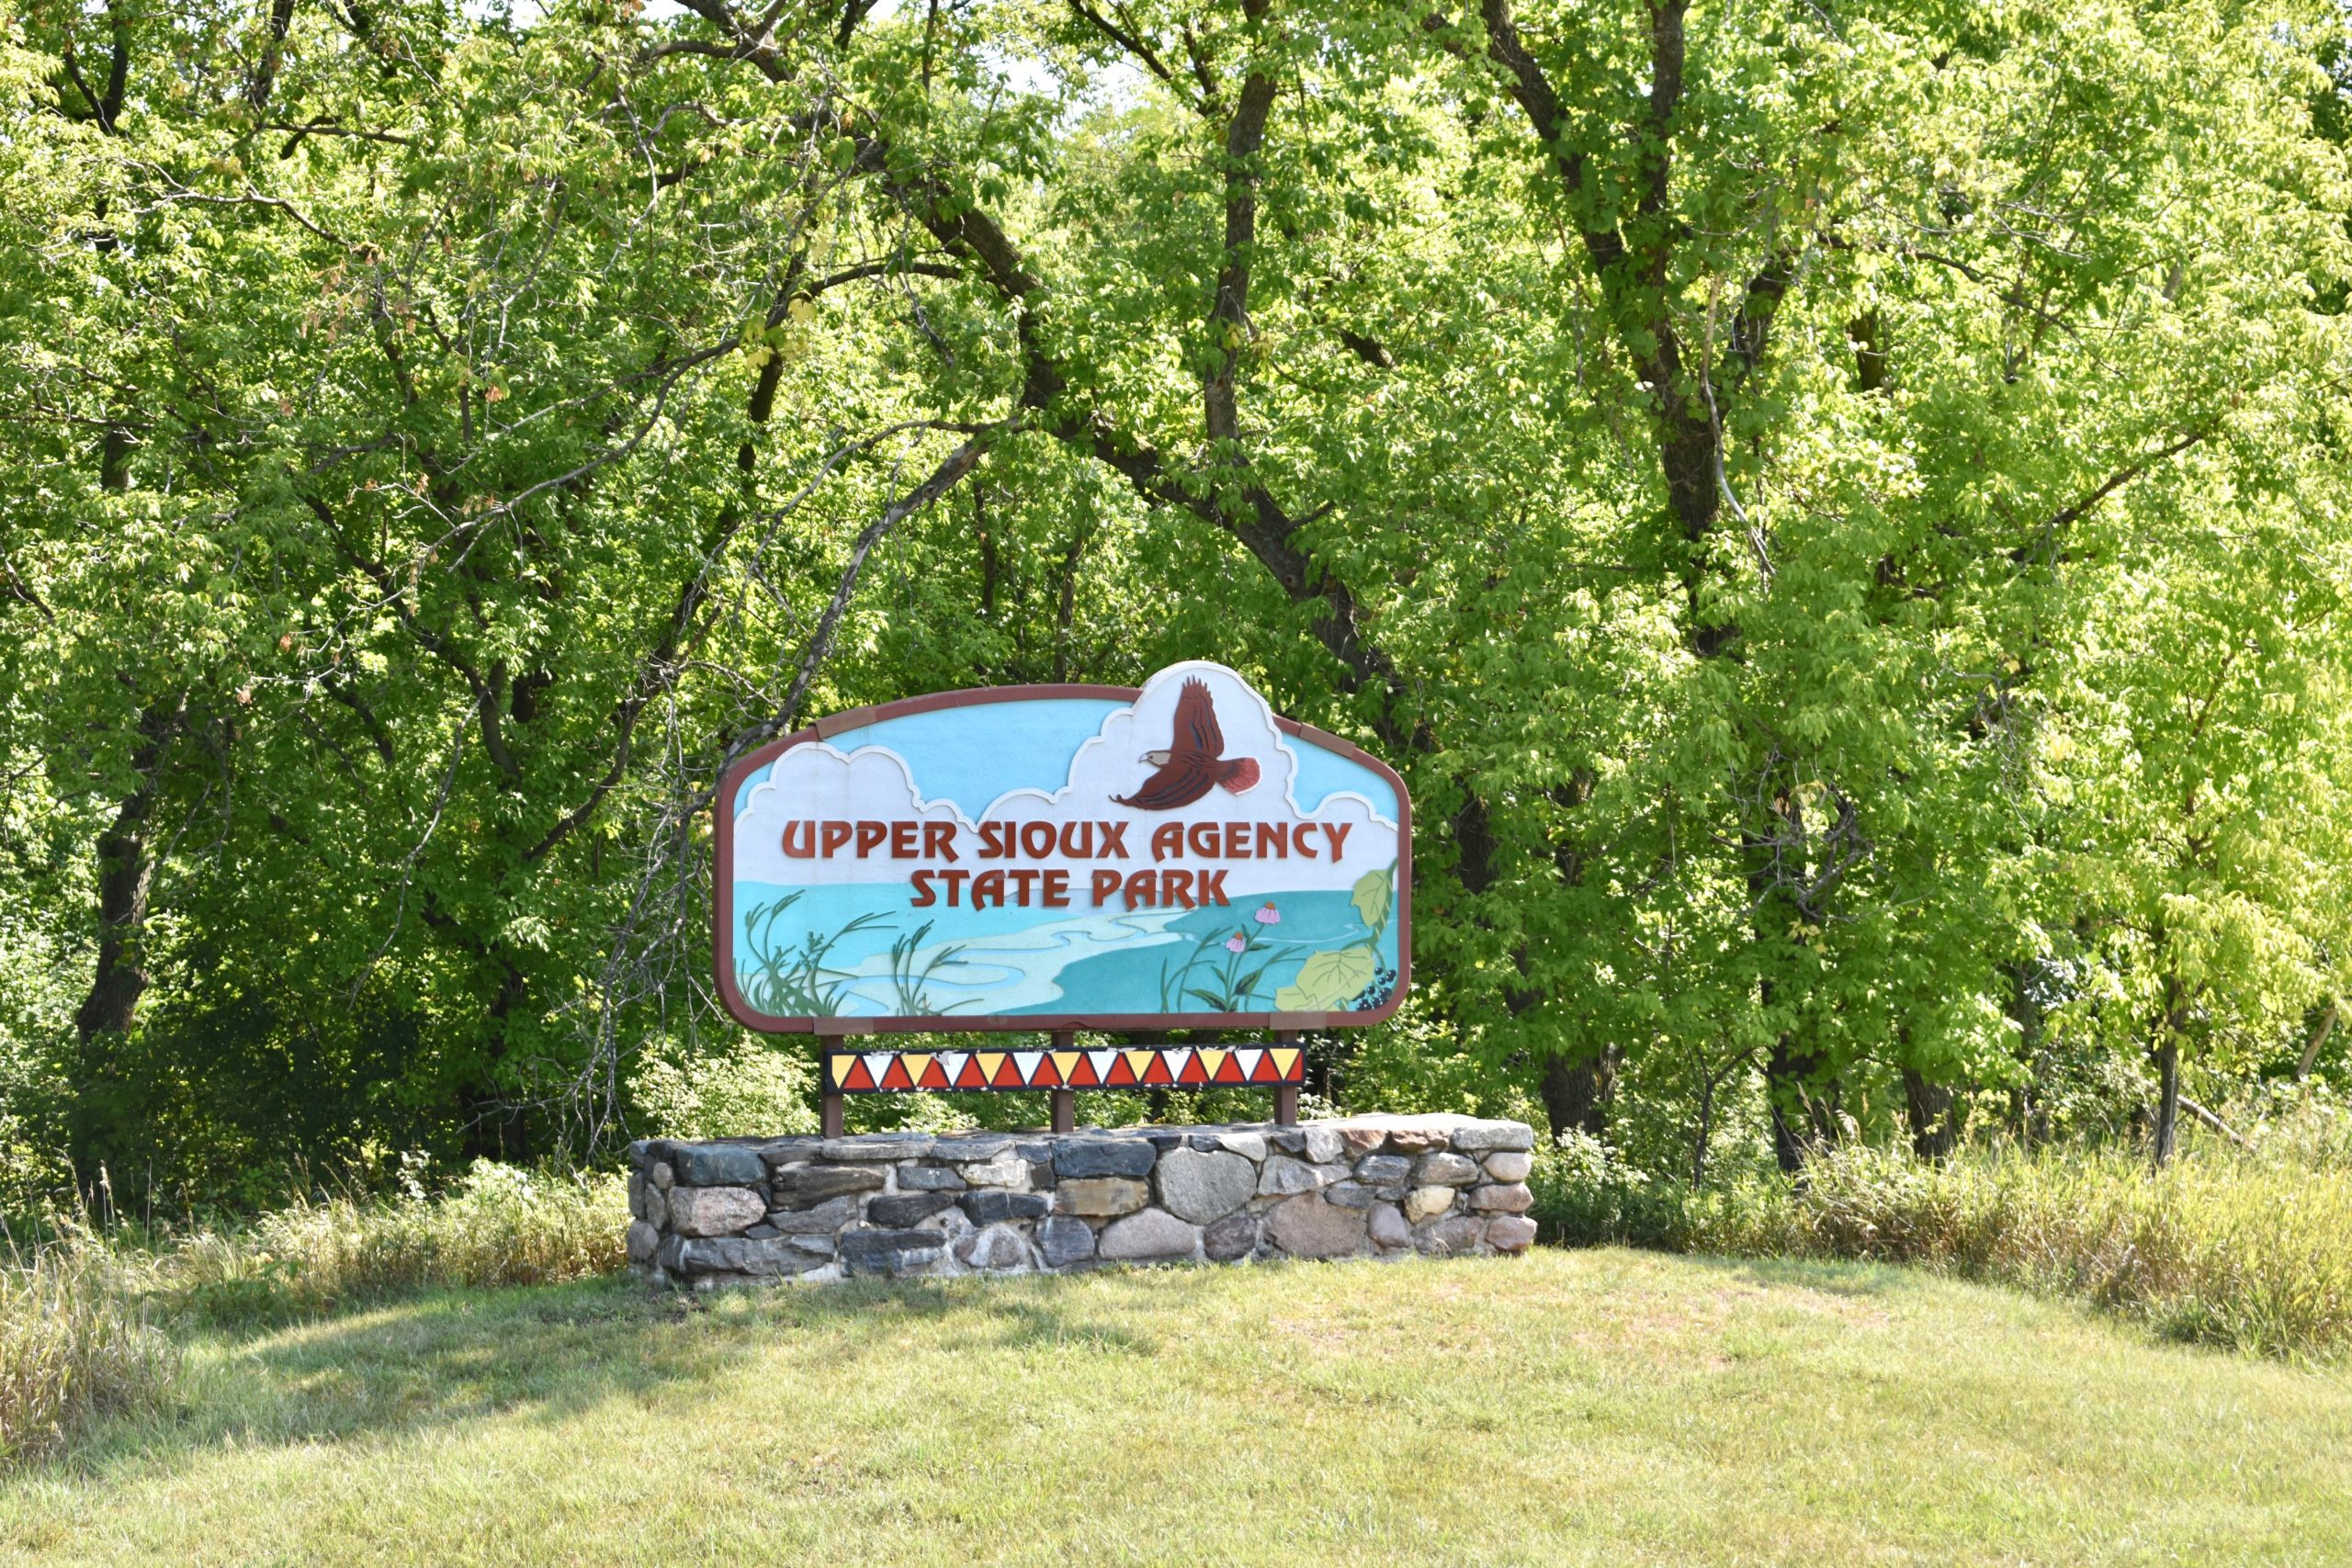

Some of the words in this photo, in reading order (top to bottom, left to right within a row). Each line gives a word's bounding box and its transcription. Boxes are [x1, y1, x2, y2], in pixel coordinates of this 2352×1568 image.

[781, 820, 960, 863] UPPER
[978, 820, 1130, 860] SIOUX
[1150, 821, 1353, 863] AGENCY
[910, 868, 1071, 910] STATE
[1091, 868, 1231, 910] PARK
